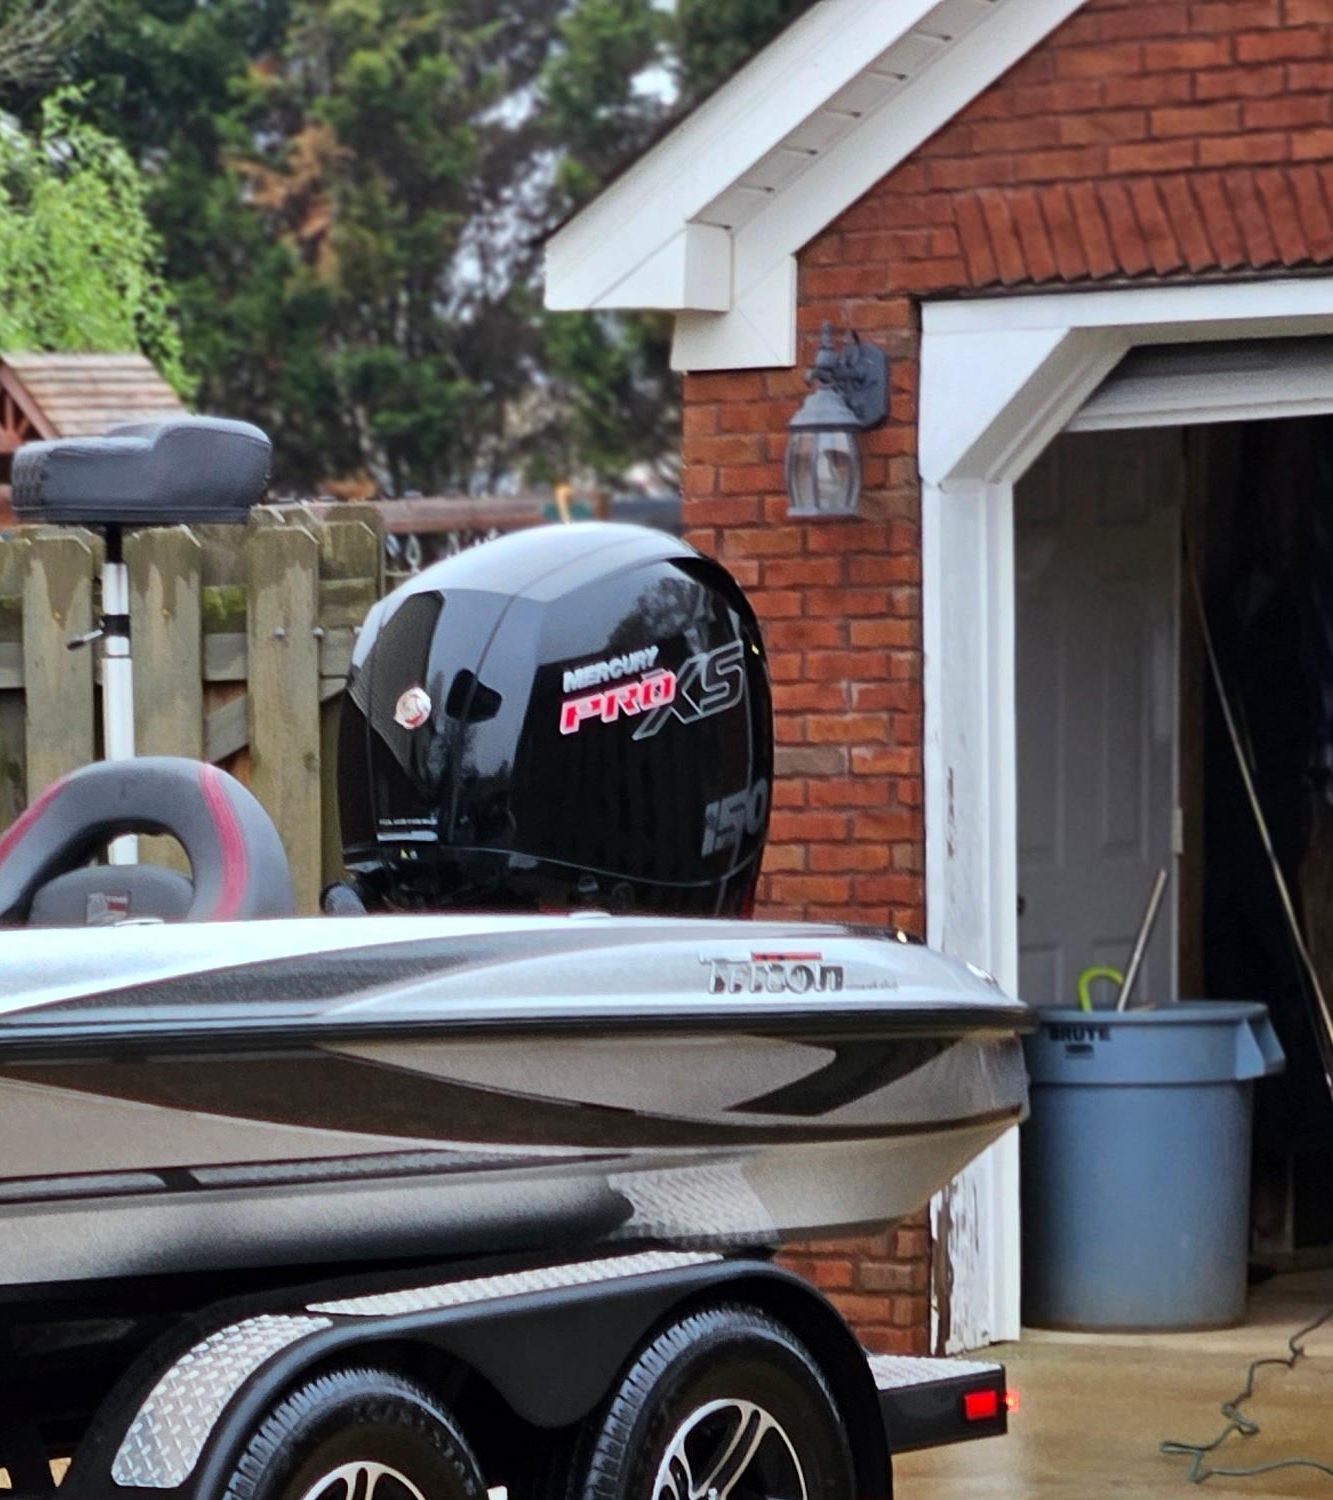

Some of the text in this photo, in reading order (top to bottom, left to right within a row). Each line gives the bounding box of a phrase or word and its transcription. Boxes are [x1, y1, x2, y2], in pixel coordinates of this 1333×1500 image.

[563, 645, 659, 693] MERCURY
[560, 668, 676, 735] PRO
[698, 951, 844, 994] Triton
